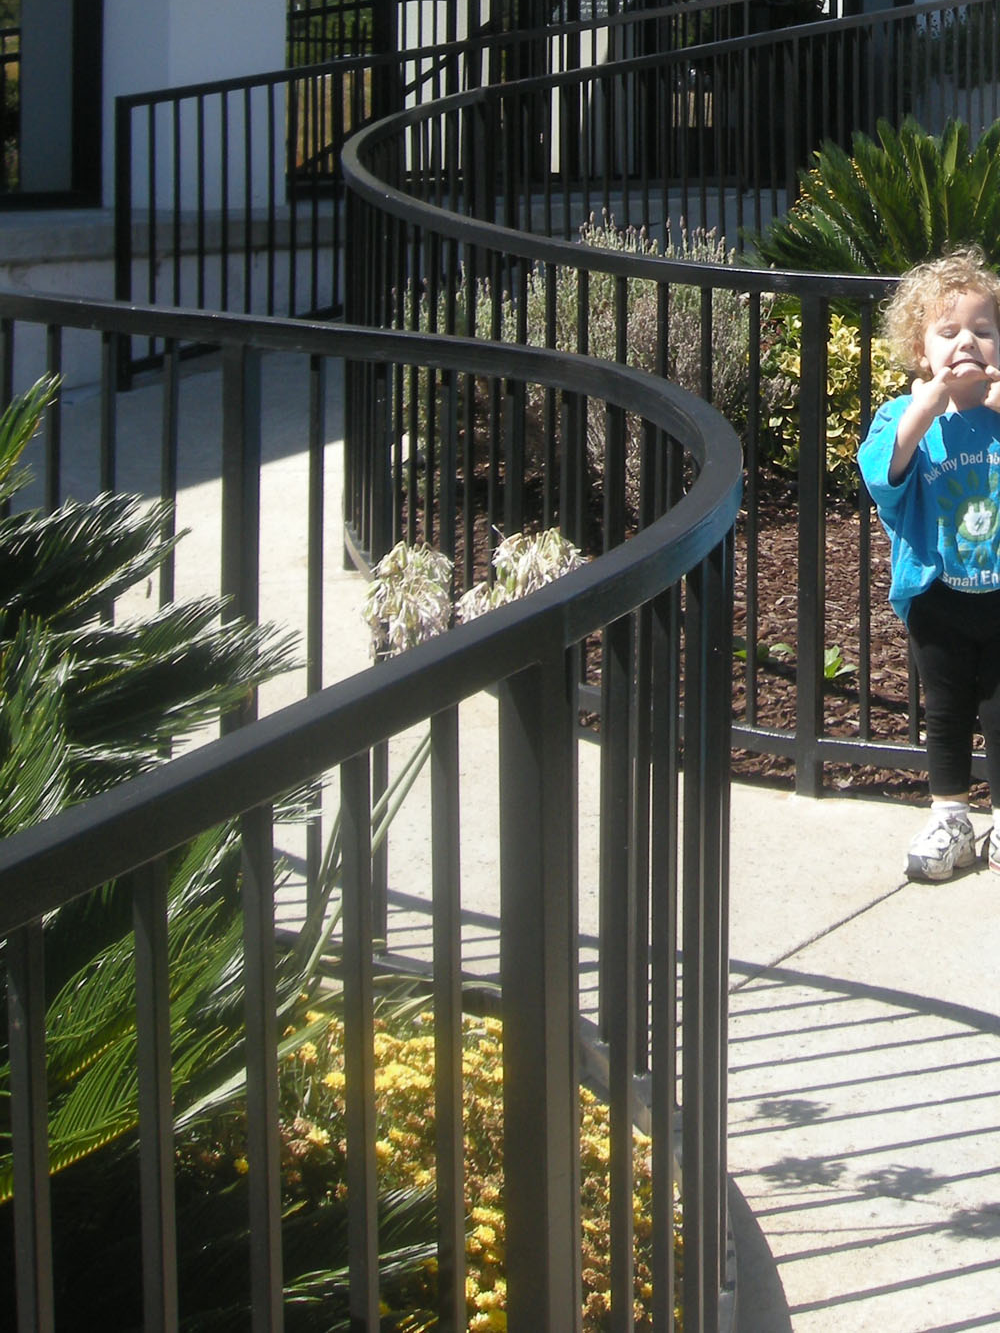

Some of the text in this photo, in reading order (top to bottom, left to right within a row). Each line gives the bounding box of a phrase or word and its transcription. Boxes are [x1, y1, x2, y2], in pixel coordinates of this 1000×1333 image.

[923, 466, 942, 485] Ask
[940, 457, 958, 472] my
[959, 450, 984, 466] Dad
[942, 570, 979, 587] Smart
